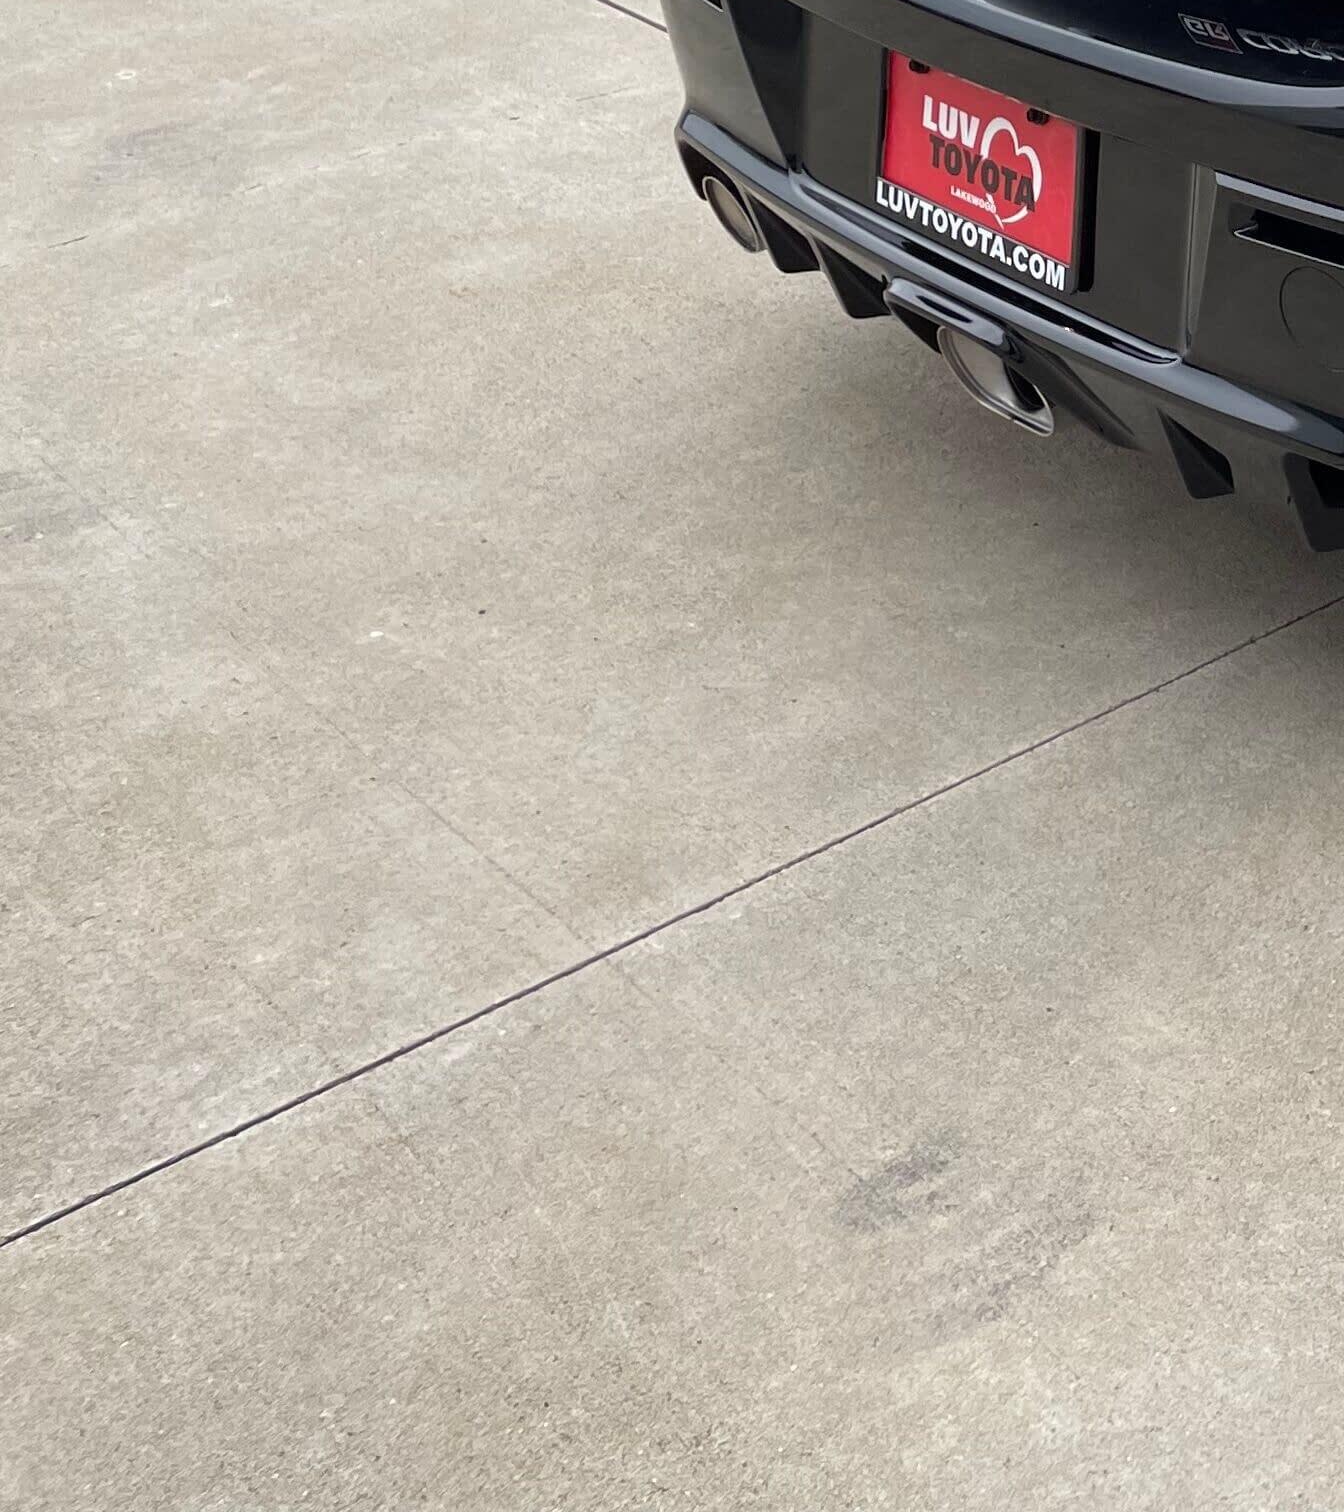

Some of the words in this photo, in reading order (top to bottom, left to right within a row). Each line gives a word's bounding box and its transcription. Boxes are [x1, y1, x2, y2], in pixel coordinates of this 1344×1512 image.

[922, 94, 980, 149] LUV
[929, 133, 1036, 212] TOYOTA
[950, 185, 997, 215] LAKEWOOD
[876, 180, 1066, 291] LUVTOYOTA.COM
